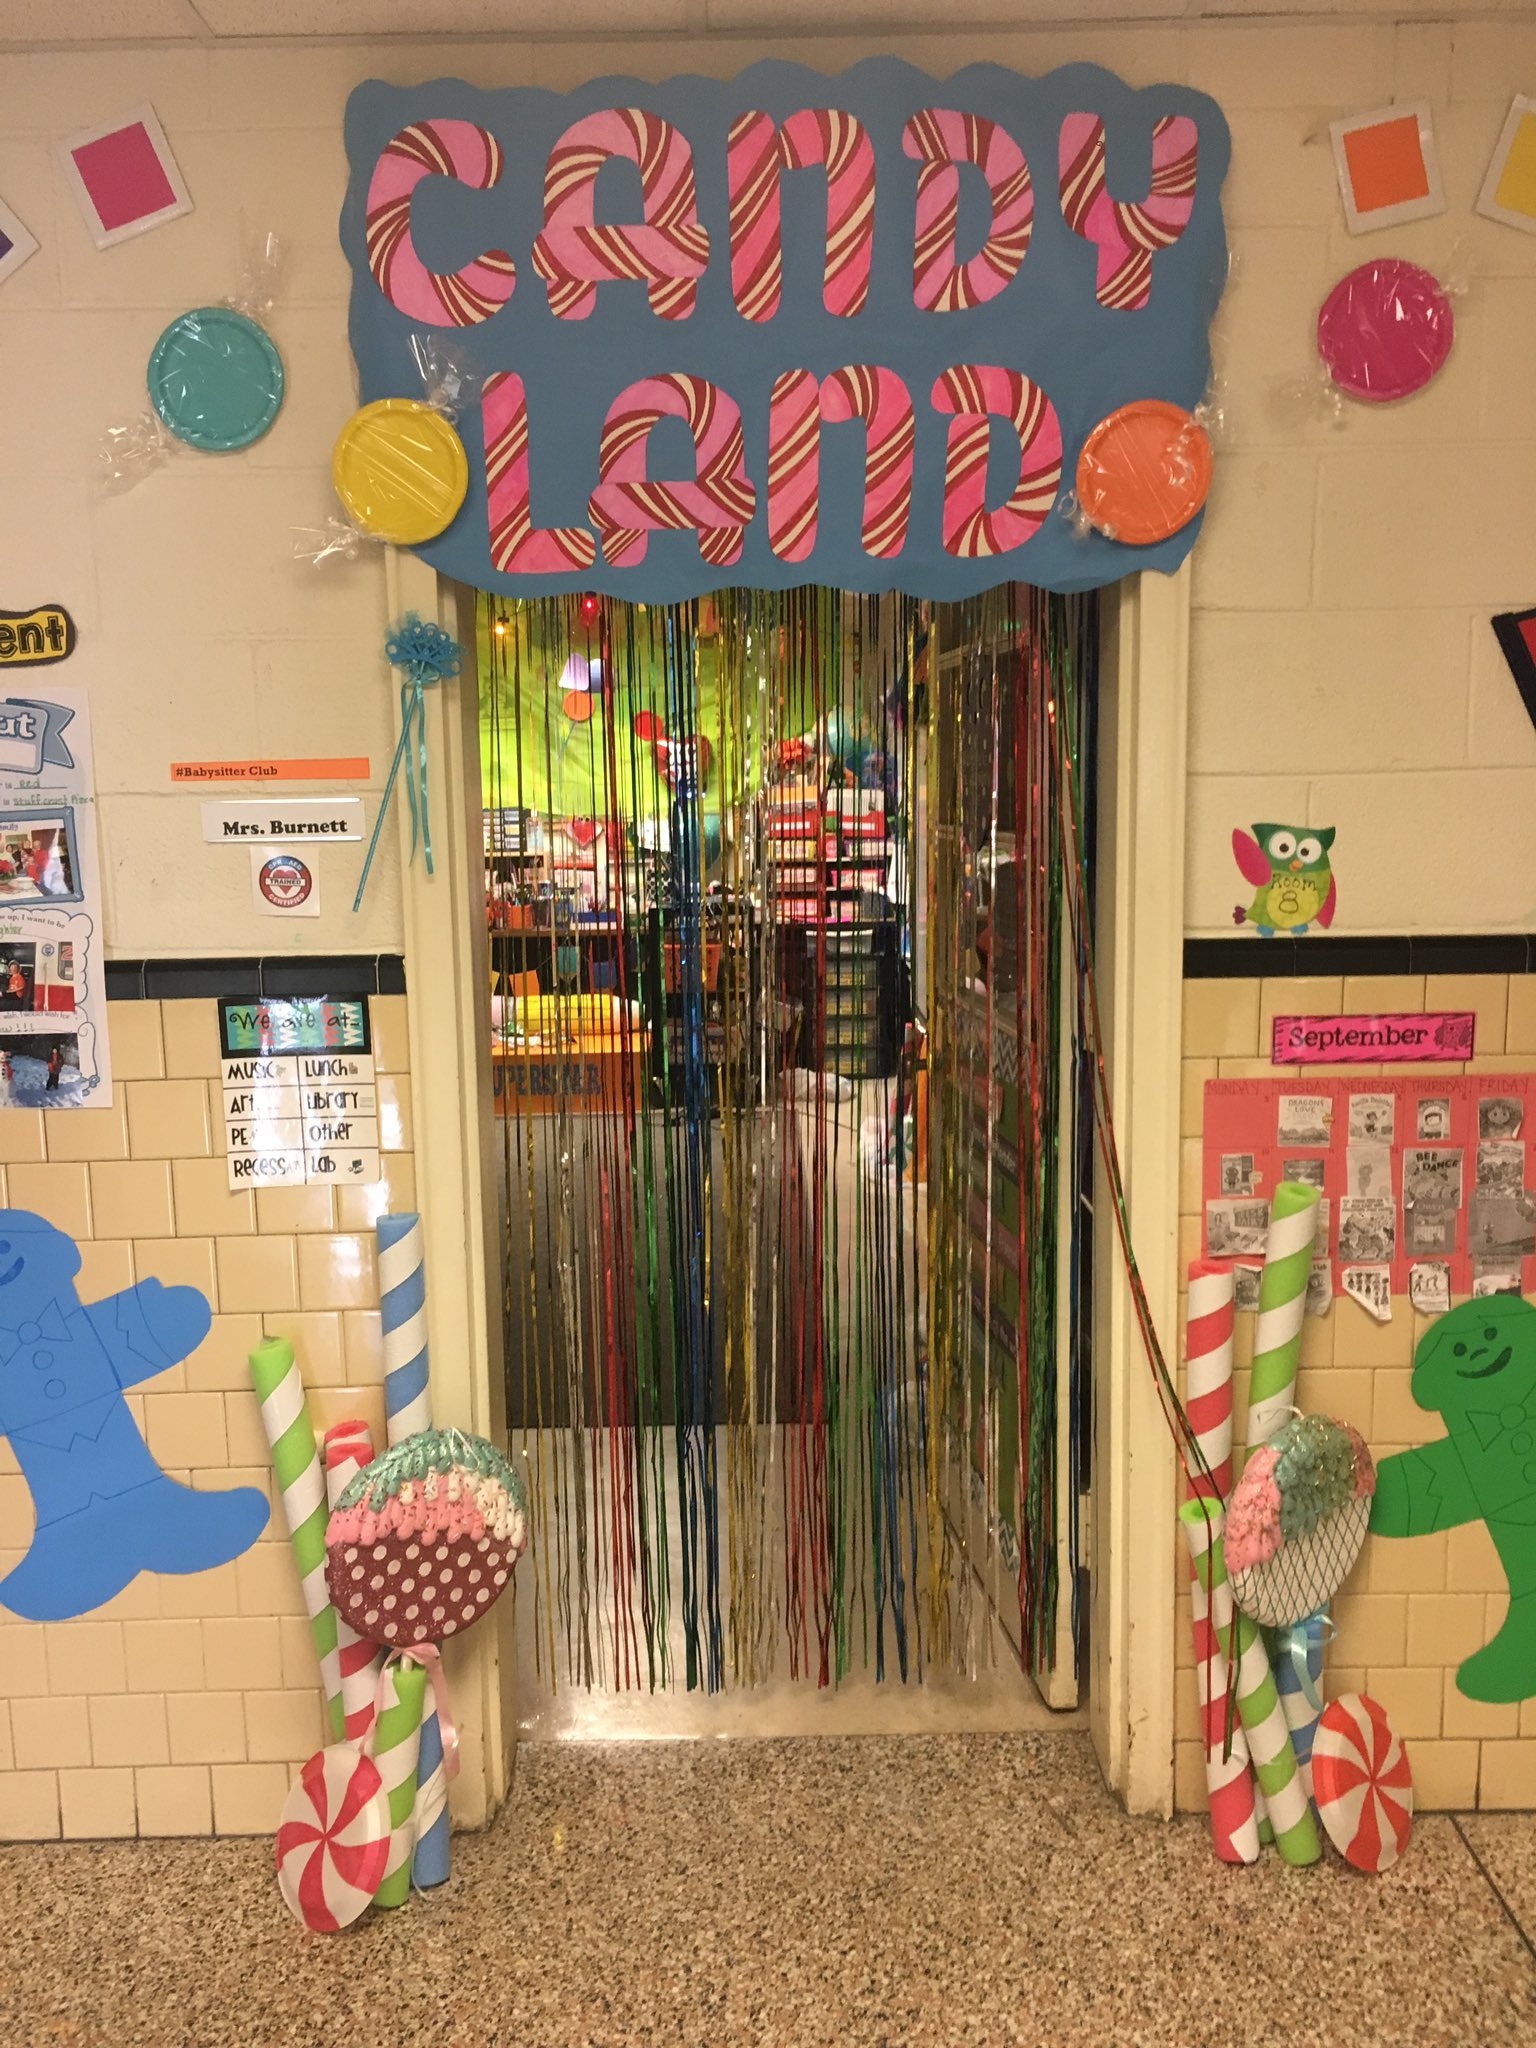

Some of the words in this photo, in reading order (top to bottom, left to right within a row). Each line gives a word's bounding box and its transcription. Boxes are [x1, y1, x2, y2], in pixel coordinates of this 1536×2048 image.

[365, 107, 1198, 327] CANDY
[481, 363, 1063, 573] LAND
[175, 766, 246, 779] #Babysitter
[249, 765, 278, 776] Club
[223, 821, 265, 836] Mrs.
[269, 819, 348, 835] Burnett
[269, 877, 302, 886] TRAINED
[268, 892, 306, 907] CERTIFIED
[1278, 890, 1299, 914] 8
[229, 1012, 270, 1030] We
[1288, 1025, 1429, 1050] September
[1277, 1079, 1331, 1095] TUESDAY
[1408, 1079, 1468, 1094] THURSDAY
[1479, 1078, 1529, 1094] FRIDAY
[231, 1128, 248, 1146] PE
[311, 1155, 336, 1174] Lab
[1416, 1152, 1438, 1162] BEE
[1422, 1158, 1460, 1174] DANCE
